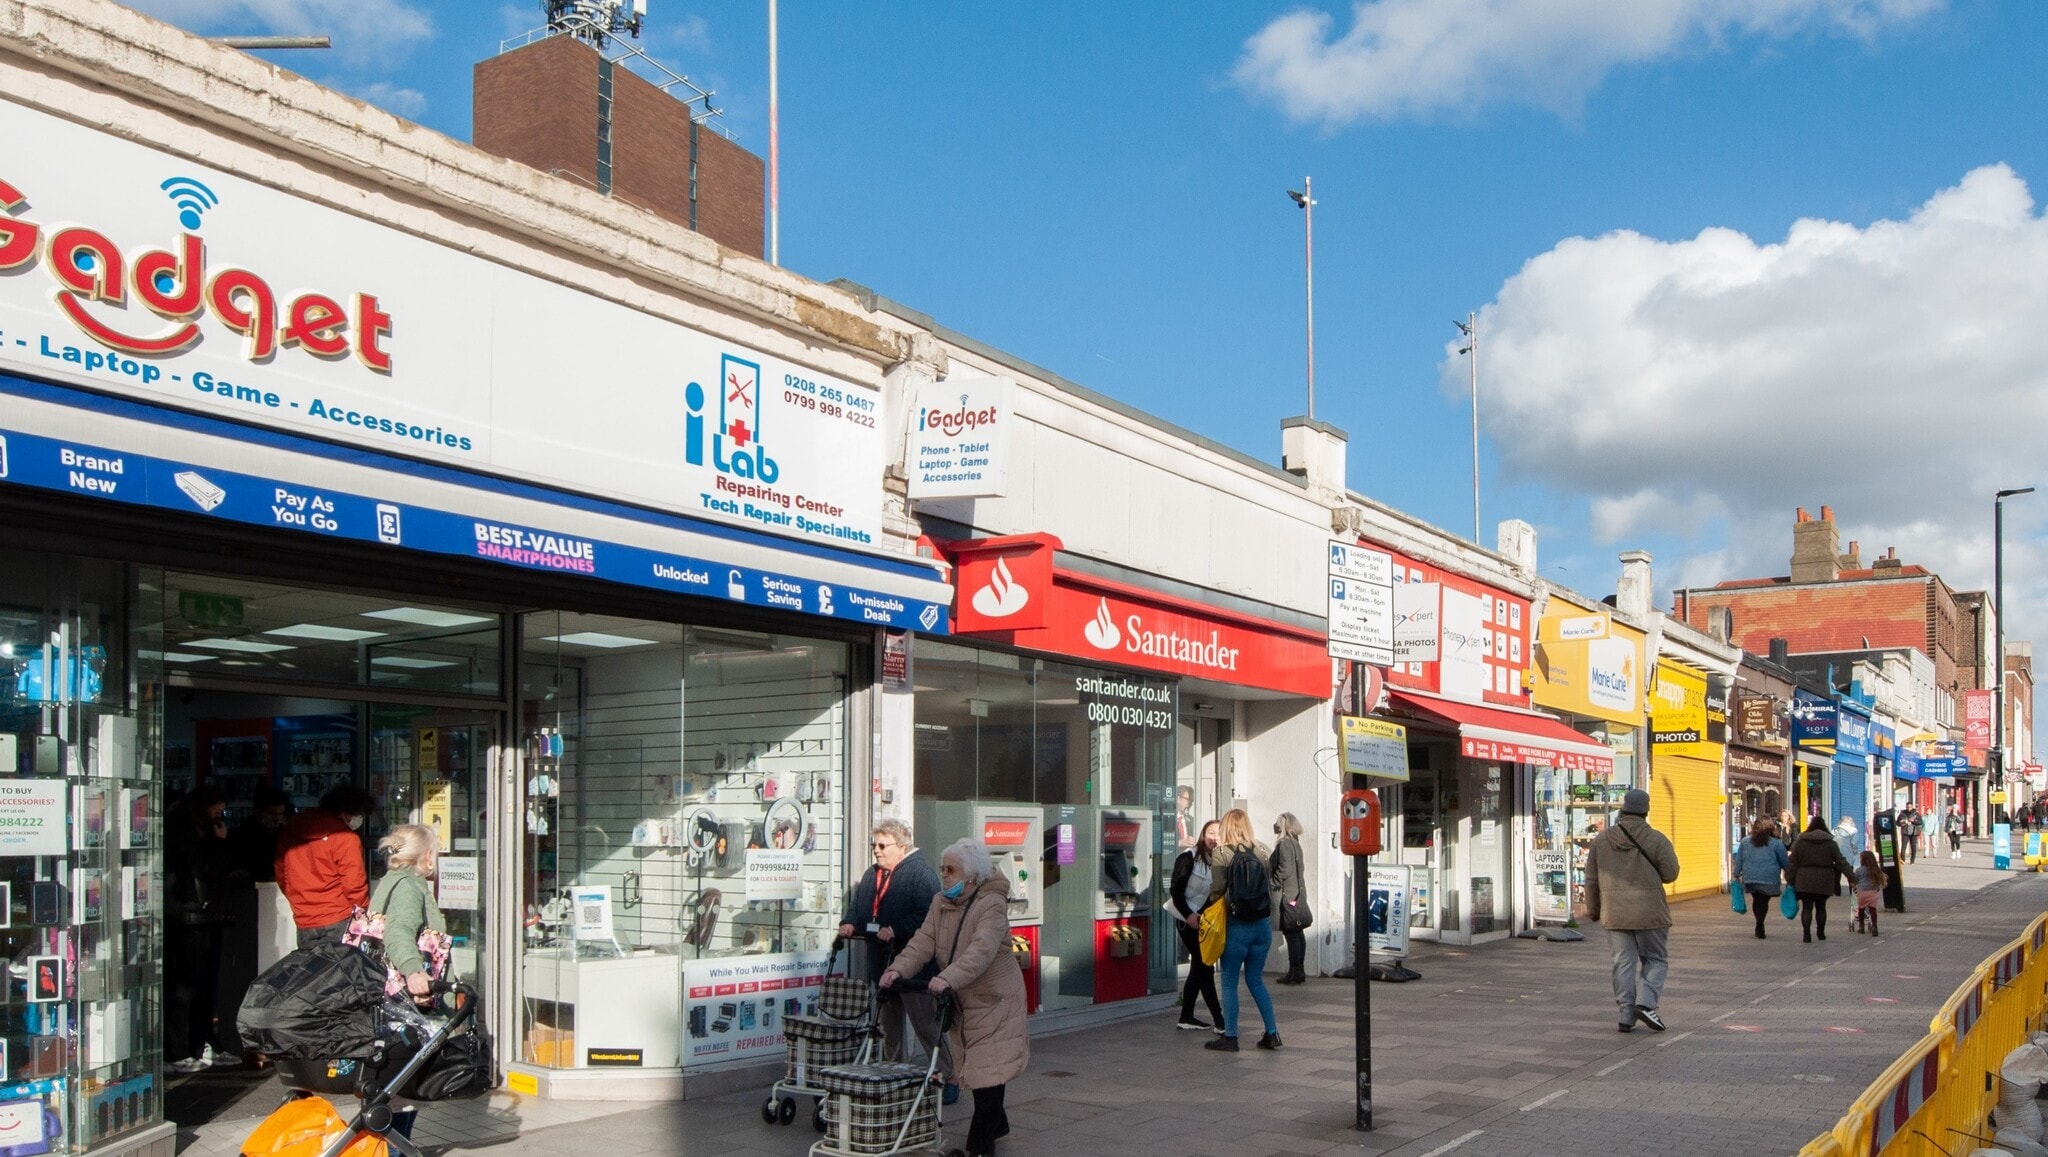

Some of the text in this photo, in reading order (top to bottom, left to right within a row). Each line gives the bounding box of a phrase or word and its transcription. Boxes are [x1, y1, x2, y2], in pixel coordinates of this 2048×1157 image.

[41, 335, 472, 450] Laptop Game Accessories
[784, 374, 875, 413] 0208 265 0487
[784, 390, 875, 429] 0799 998 4222
[919, 405, 997, 432] iGadget
[921, 443, 989, 455] Phone Tablet
[60, 448, 124, 474] Brand
[919, 458, 989, 470] Laptop Game
[69, 471, 117, 494] New
[923, 472, 982, 482] Accessories
[275, 488, 334, 512] Pay As
[716, 475, 844, 518] Repairing Center
[272, 506, 338, 531] You Go
[700, 493, 871, 543] Tech Repair Specialists
[474, 523, 594, 560] BEST-VALUE
[477, 542, 595, 573] SMARTPHONES
[1350, 550, 1384, 563] Loading only
[1354, 560, 1366, 569] Mon
[653, 563, 709, 584] Unlocked
[762, 577, 802, 594] Serious
[1355, 585, 1380, 596] Mon Sat
[767, 591, 802, 610] Saving
[850, 592, 904, 612] Un-missable
[864, 608, 891, 623] Deals
[1340, 603, 1350, 611] Pay
[1360, 606, 1382, 616] machine
[1341, 621, 1380, 634] Display ticket
[1126, 614, 1239, 671] Santander
[1332, 629, 1358, 640] Maximum
[1360, 634, 1372, 643] stay
[1379, 637, 1390, 645] hour
[1404, 639, 1436, 647] PHOTOS
[1332, 645, 1340, 653] No
[1341, 647, 1353, 655] limit
[1362, 650, 1375, 658] other
[1377, 653, 1390, 662] times
[1592, 667, 1626, 692] Marie Curie
[1076, 676, 1171, 704] santander.co.uk
[1088, 702, 1172, 729] 0800 030 4321
[1358, 720, 1394, 734] No Parking
[1655, 732, 1697, 742] PHOTOS
[994, 829, 1024, 838] Santander
[1111, 829, 1137, 838] Santander
[750, 863, 799, 871] 07999984222
[1534, 854, 1565, 863] LAPTOPS
[441, 871, 475, 880] 07999984222
[1373, 871, 1399, 880] iPhone
[710, 959, 828, 978] While You Wait Repair Services
[736, 1034, 787, 1050] REPAIRED HE
